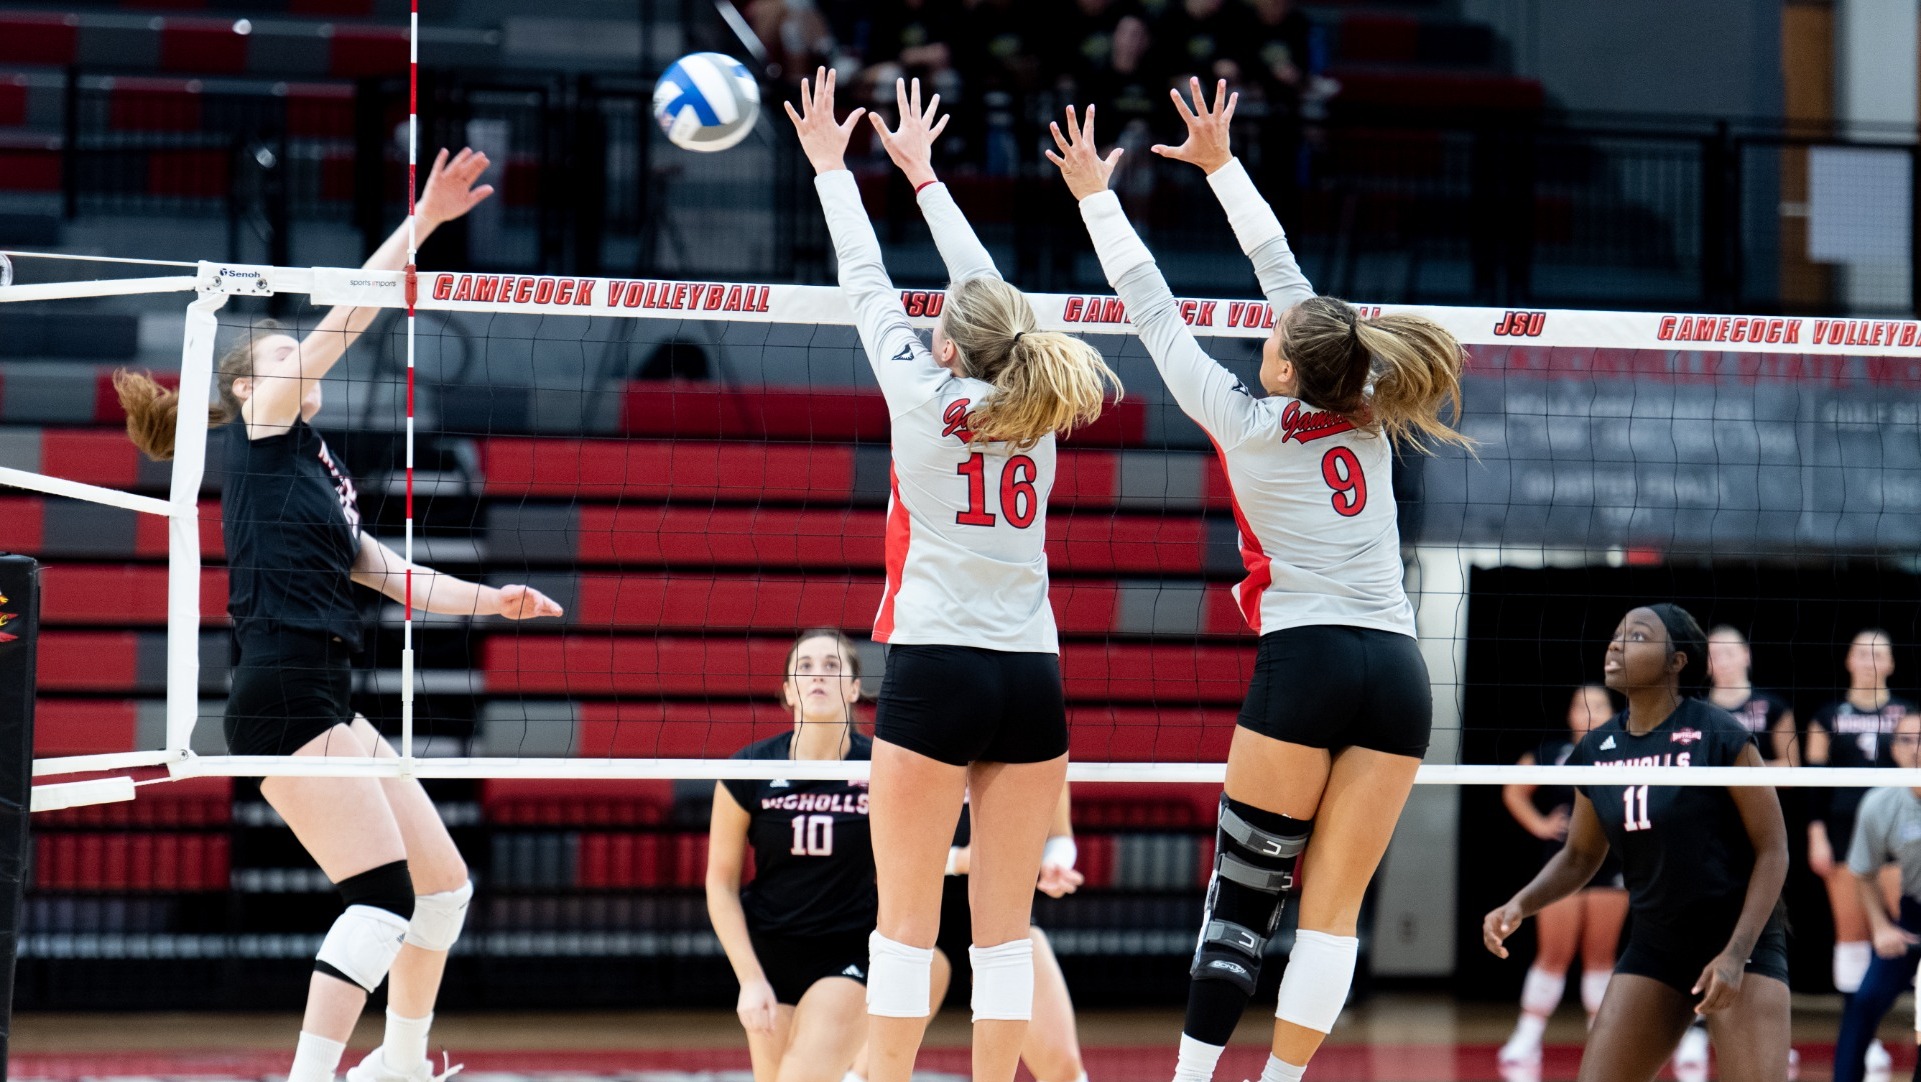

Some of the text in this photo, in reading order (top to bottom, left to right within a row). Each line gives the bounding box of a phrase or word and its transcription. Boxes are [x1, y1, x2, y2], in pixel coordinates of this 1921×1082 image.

[228, 269, 261, 278] Senoh
[349, 279, 397, 288] sports imports
[432, 273, 770, 312] GAMECOCK VOLLEYBALL
[1493, 310, 1547, 337] JSU
[1657, 315, 1921, 348] GAMECOCK VOLLEYB
[955, 451, 1037, 529] 16
[1321, 446, 1367, 517] 9
[1623, 784, 1652, 832] 11
[790, 814, 834, 857] 10
